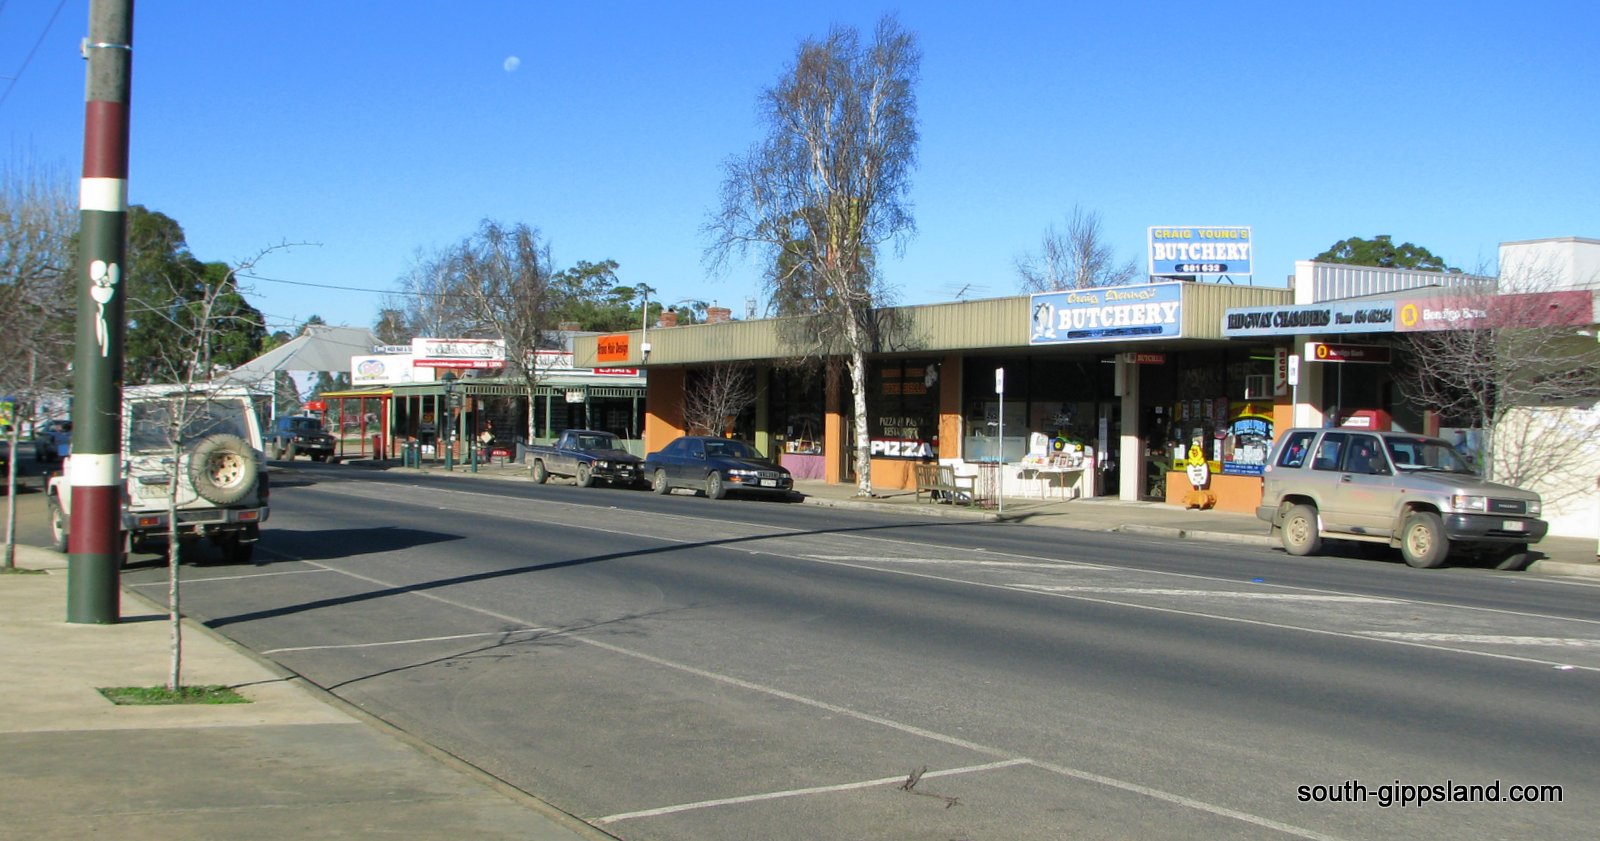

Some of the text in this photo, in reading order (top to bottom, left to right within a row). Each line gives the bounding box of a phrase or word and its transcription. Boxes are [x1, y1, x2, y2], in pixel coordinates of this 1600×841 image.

[1154, 229, 1249, 239] CRAIG YOUNG'S
[1154, 242, 1249, 261] BUTCHERY
[1057, 301, 1180, 330] BUTCHERY
[1227, 311, 1273, 330] RIDGWAY
[1272, 309, 1331, 328] CHAMBERS
[870, 440, 934, 458] PIZZA
